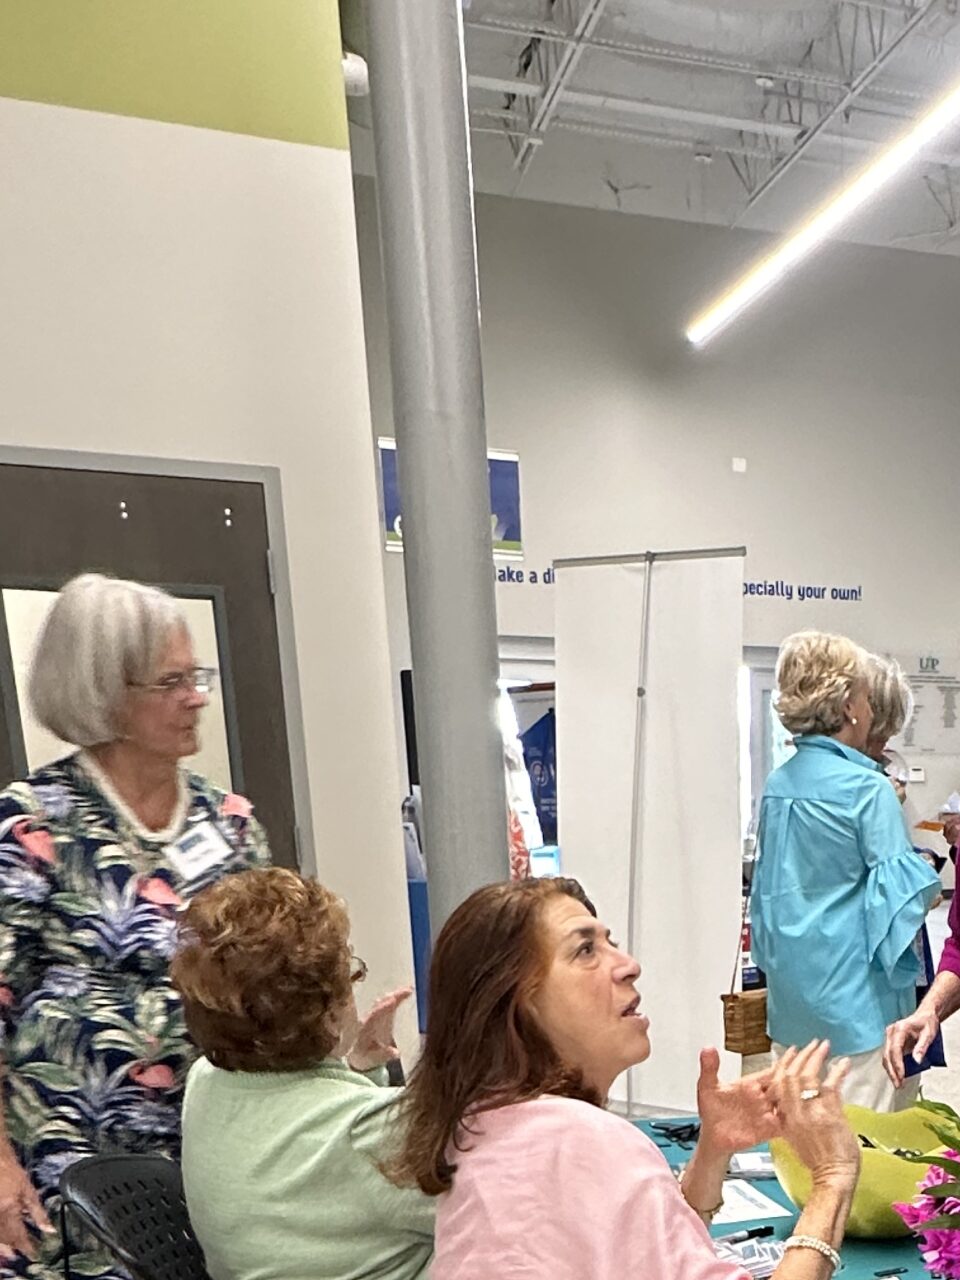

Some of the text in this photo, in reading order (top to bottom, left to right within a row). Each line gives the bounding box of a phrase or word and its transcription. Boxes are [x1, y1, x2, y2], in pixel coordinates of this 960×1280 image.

[494, 566, 524, 583] ake
[529, 571, 538, 583] a
[797, 585, 827, 601] your
[830, 586, 862, 601] own!
